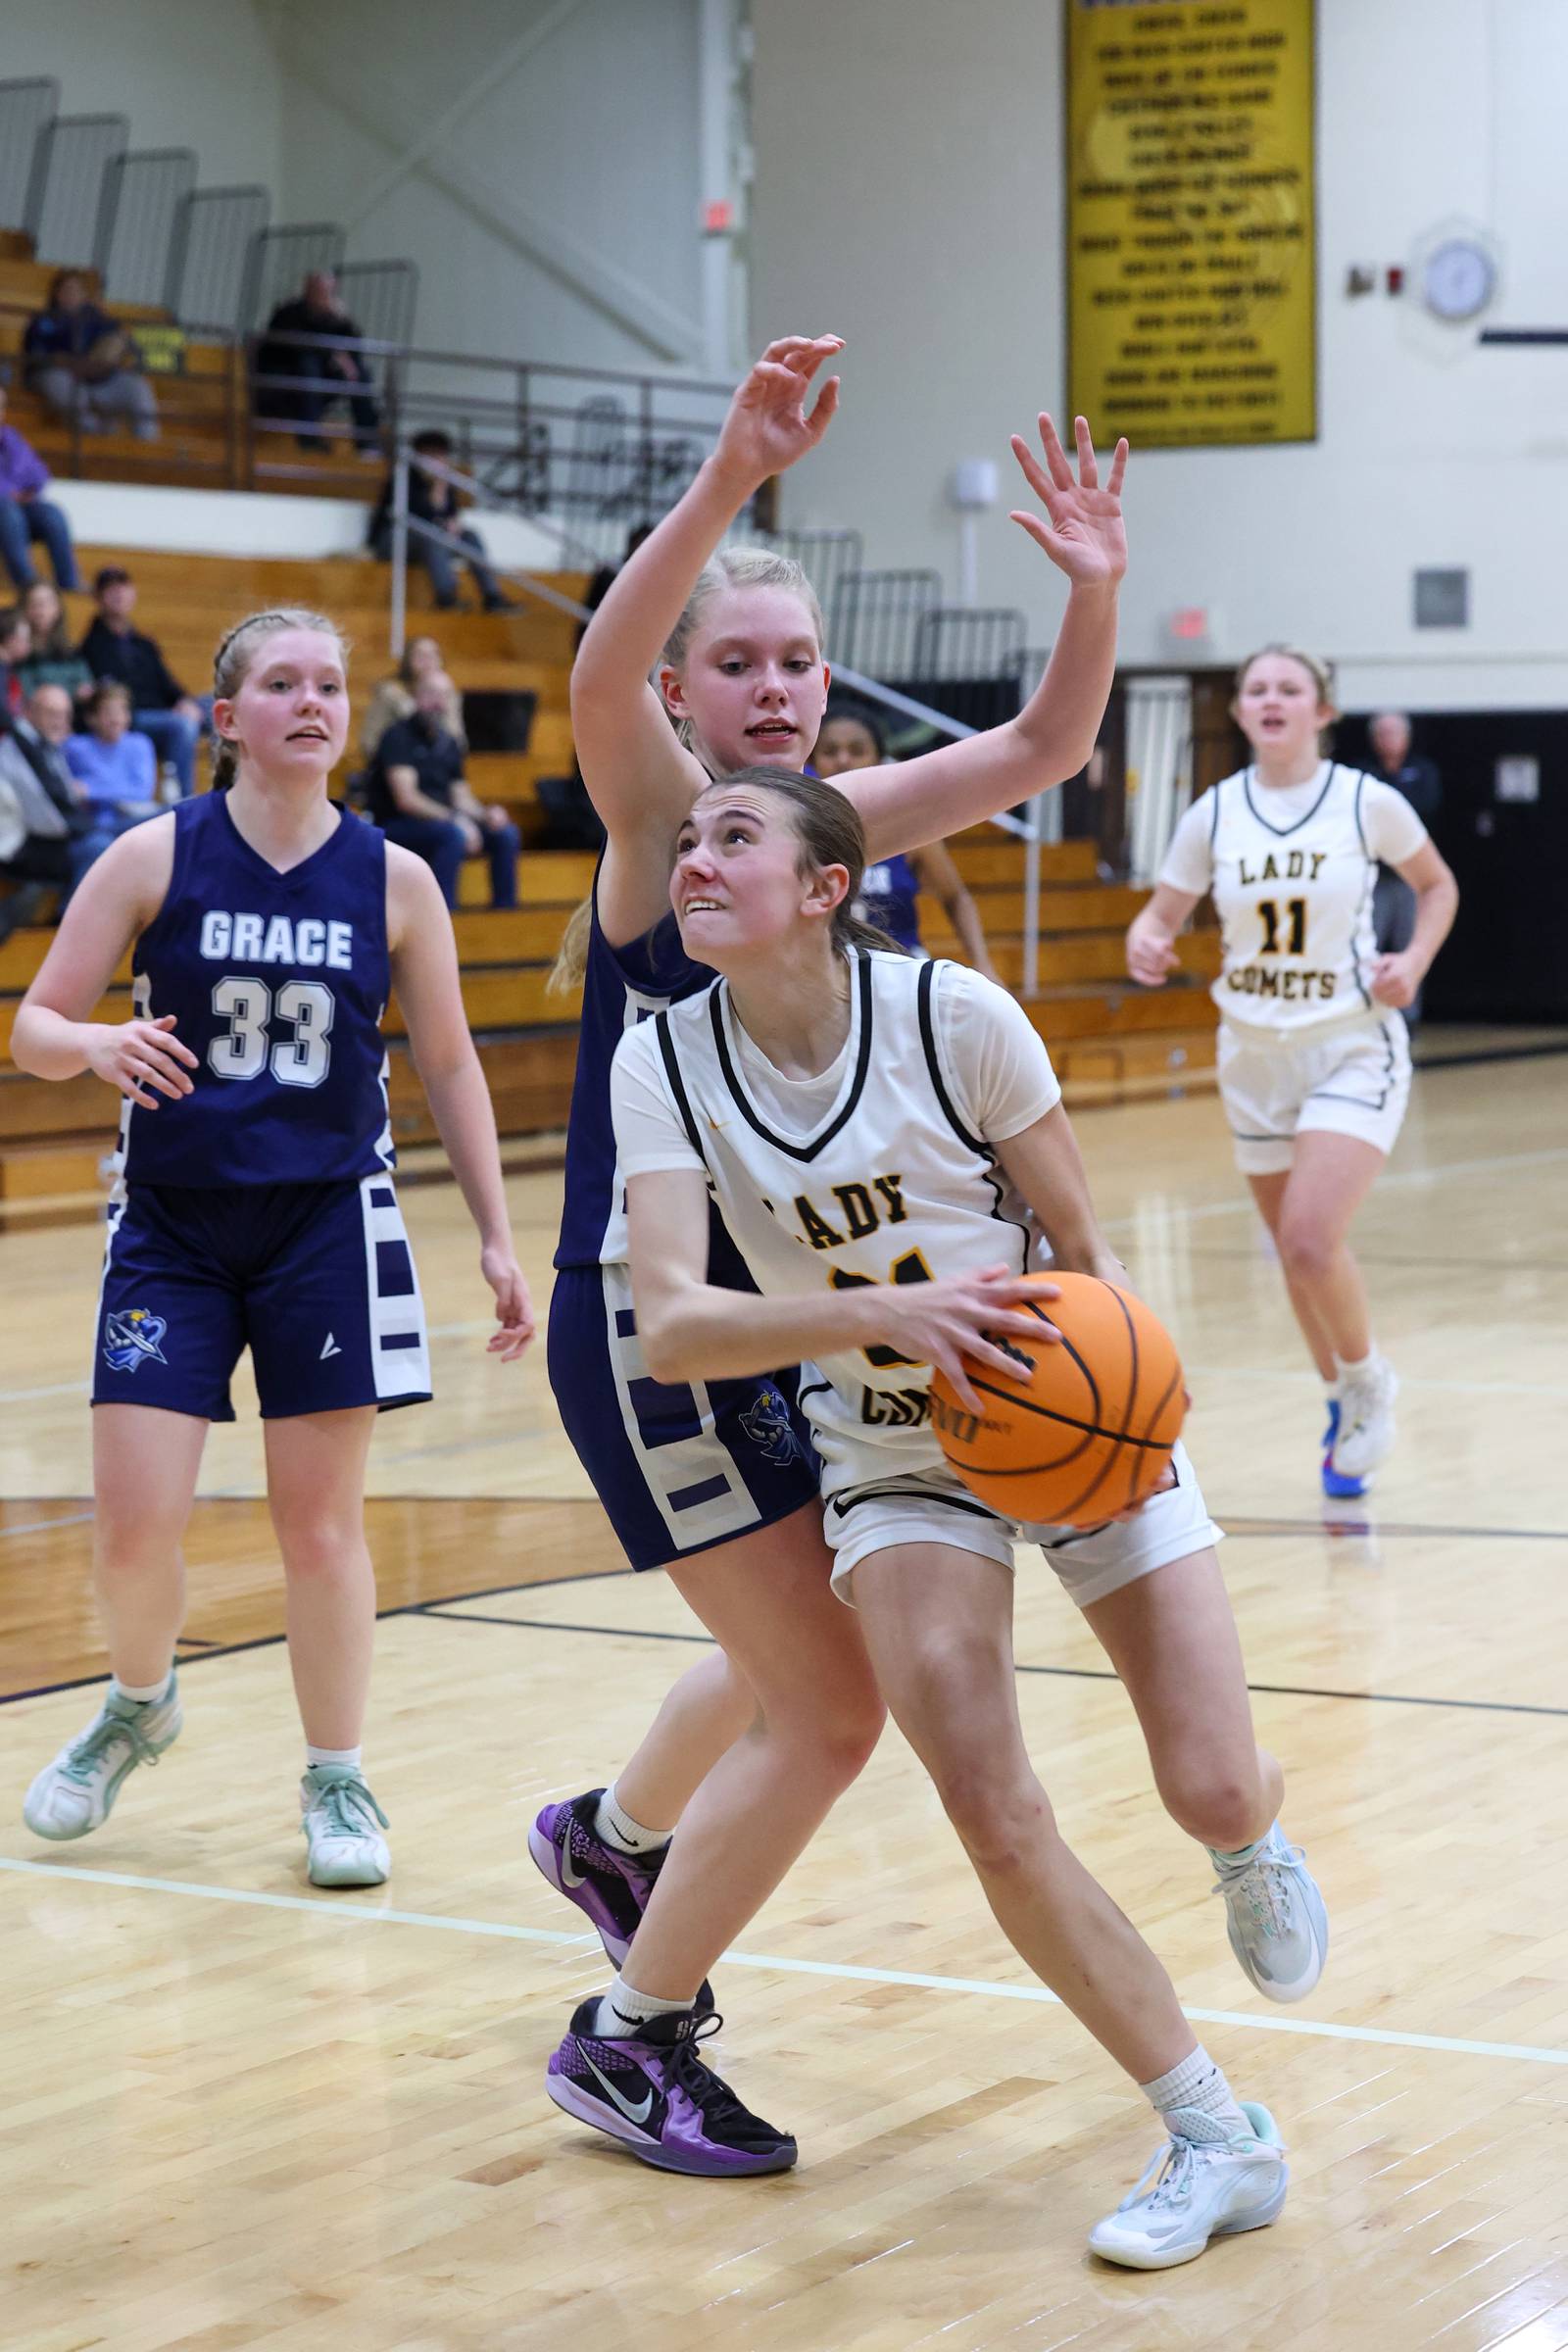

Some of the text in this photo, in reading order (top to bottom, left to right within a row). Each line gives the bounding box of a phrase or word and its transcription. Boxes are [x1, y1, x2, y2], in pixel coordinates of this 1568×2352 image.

[1239, 851, 1327, 885] LADY
[199, 909, 354, 971] GRACE
[1256, 896, 1307, 956] 11
[1227, 964, 1337, 1000] COMETS
[207, 975, 336, 1089] 33
[761, 1174, 909, 1251] ADY
